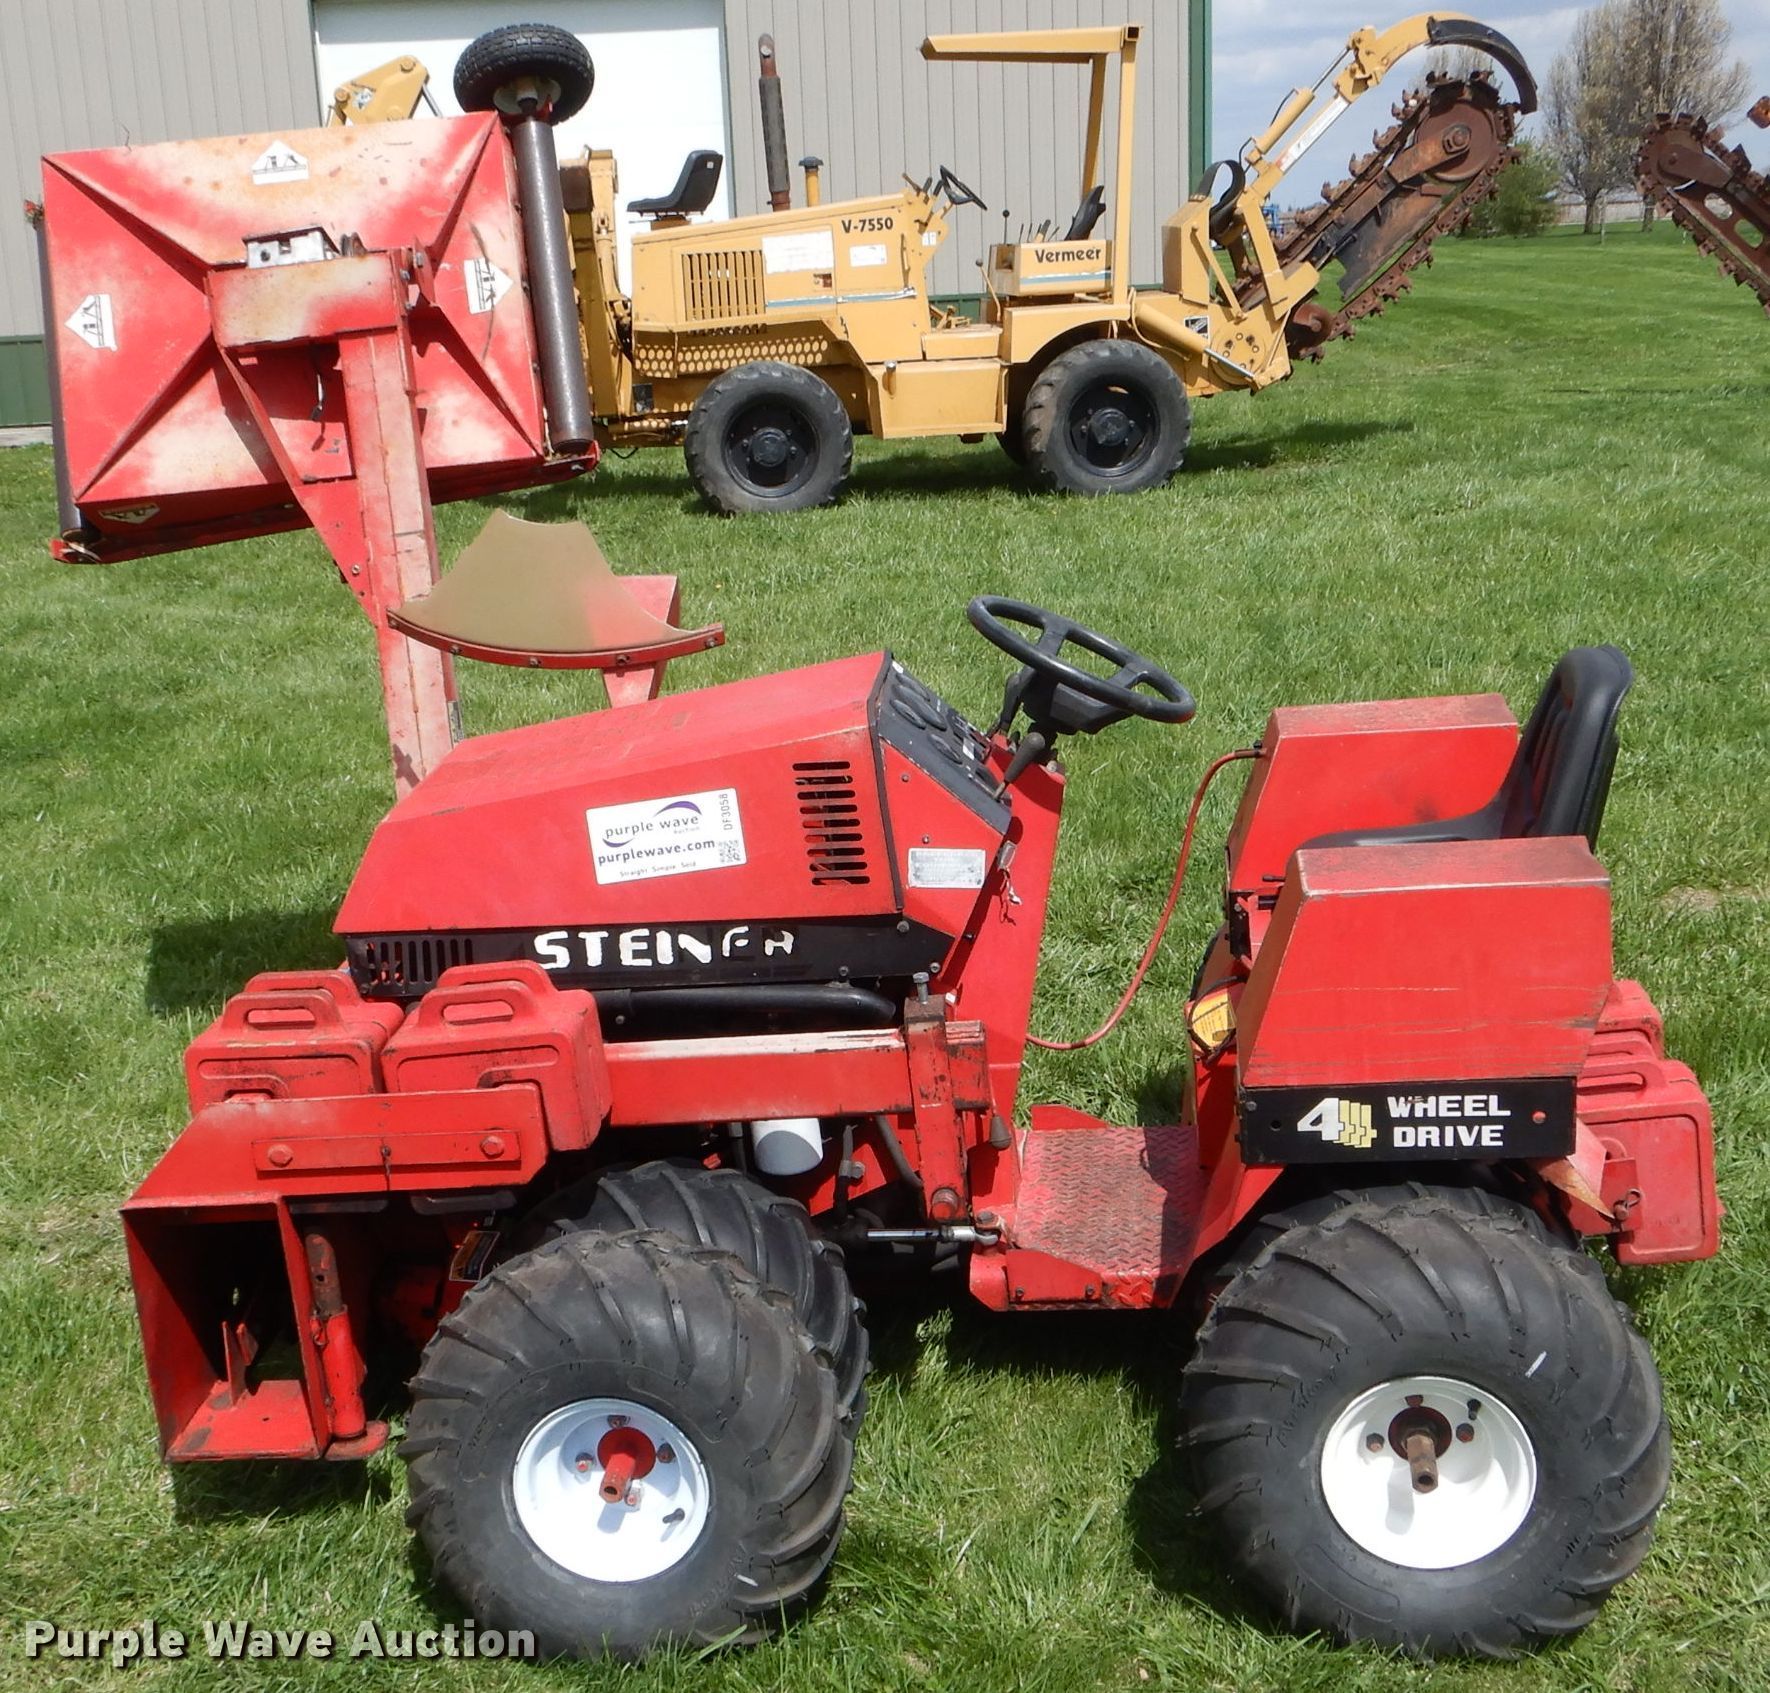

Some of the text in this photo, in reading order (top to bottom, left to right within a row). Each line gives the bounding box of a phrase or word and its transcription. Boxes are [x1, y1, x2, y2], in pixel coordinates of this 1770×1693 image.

[841, 217, 893, 233] V-7550
[1035, 247, 1101, 264] Vermeer
[605, 816, 699, 839] purple wave
[598, 840, 715, 867] purplewave.com
[1387, 1095, 1511, 1118] WHEEL
[1393, 1125, 1503, 1148] DRIVE
